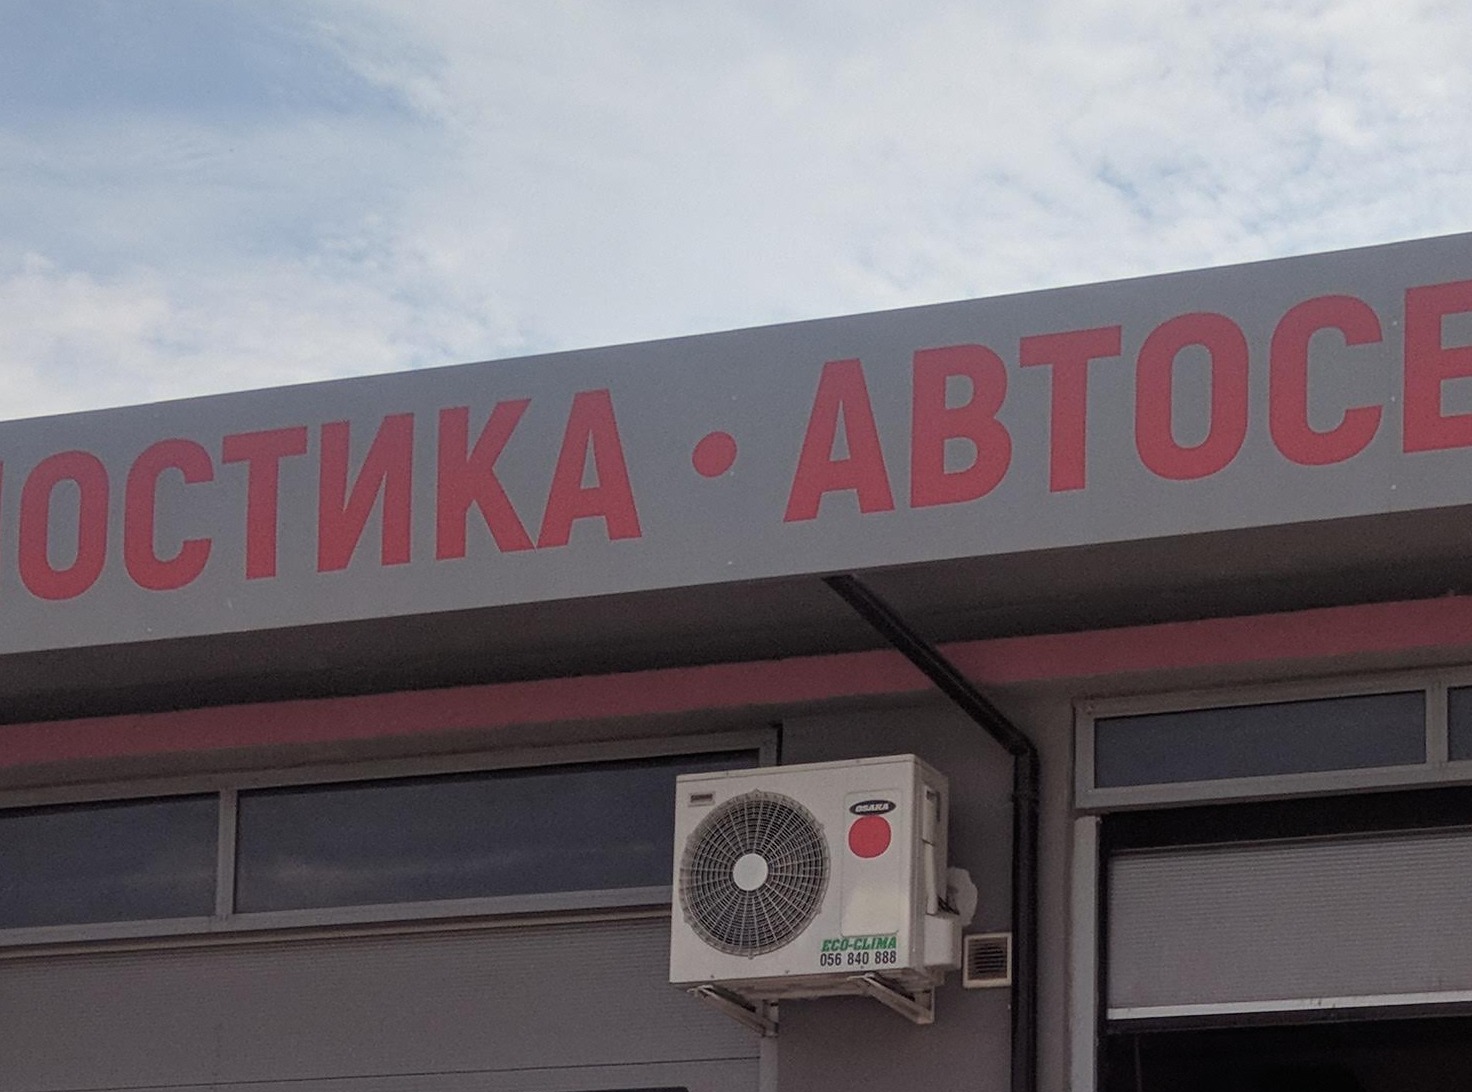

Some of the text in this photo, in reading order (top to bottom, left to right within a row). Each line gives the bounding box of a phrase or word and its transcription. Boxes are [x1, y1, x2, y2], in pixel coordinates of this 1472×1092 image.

[0, 387, 643, 601] ОСТИКА
[821, 936, 897, 952] ECO-CLIMA
[820, 950, 897, 966] 056 840 888
